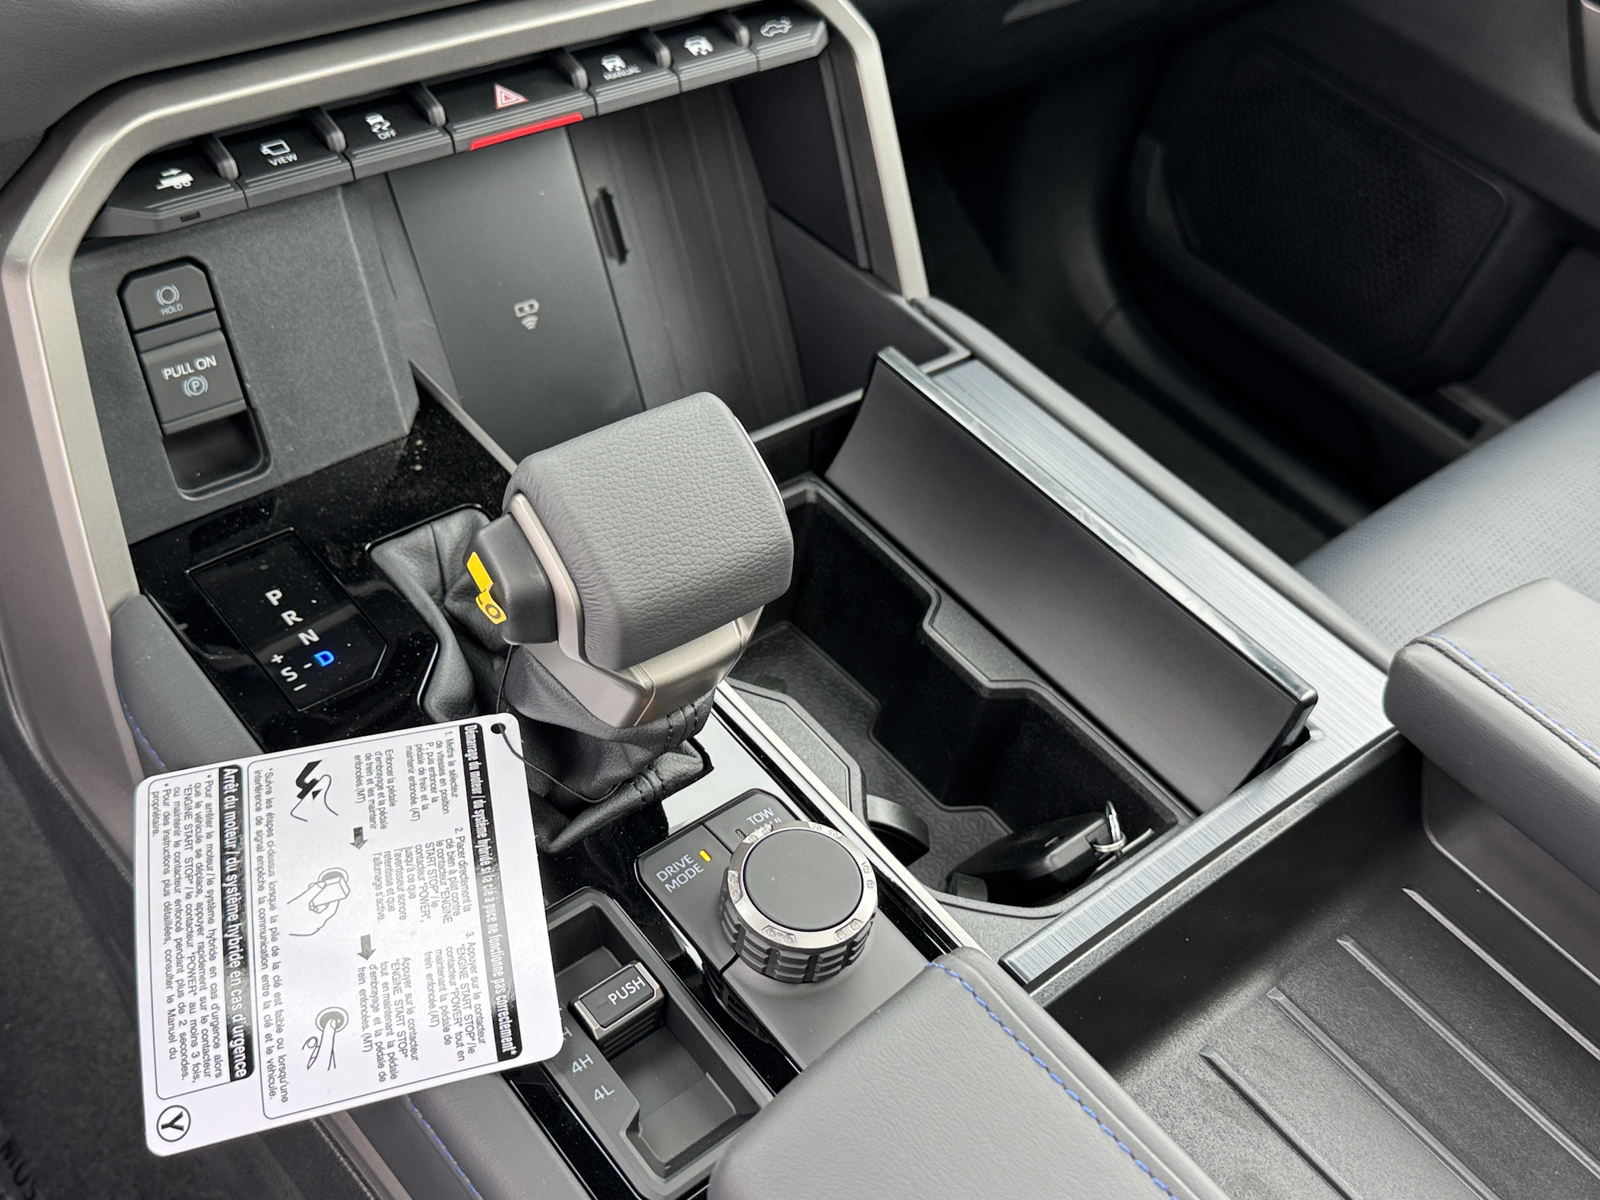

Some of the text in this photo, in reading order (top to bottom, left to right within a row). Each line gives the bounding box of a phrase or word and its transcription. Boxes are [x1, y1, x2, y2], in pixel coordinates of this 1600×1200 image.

[377, 127, 397, 140] OFF
[268, 152, 298, 166] VIEW
[161, 303, 183, 316] HOLD
[162, 355, 217, 380] PULL ON
[265, 589, 283, 606] P
[281, 610, 304, 626] R
[298, 628, 320, 646] N
[313, 650, 335, 668] D
[461, 724, 480, 761] Démarrage
[384, 749, 394, 776] Enfoncer
[468, 760, 481, 770] du
[173, 786, 179, 797] ou
[192, 782, 201, 797] que
[204, 780, 213, 798] Pour
[223, 767, 236, 793] Arrêt
[469, 770, 484, 795] moteur
[195, 800, 203, 808] le
[224, 794, 237, 809] du
[265, 797, 273, 809] les
[385, 784, 397, 807] pédale
[473, 798, 486, 808] du
[149, 791, 160, 836] propriétaire.
[173, 800, 182, 836] maintenir
[205, 802, 213, 828] arrêter
[263, 811, 275, 837] étapes
[471, 808, 490, 839] système
[746, 807, 774, 825] TOW
[184, 823, 193, 851] START
[195, 811, 204, 843] véhicule
[206, 831, 214, 839] le
[224, 810, 238, 849] moteur
[174, 839, 182, 847] le
[196, 848, 202, 858] se
[455, 836, 465, 859] Placer
[474, 838, 493, 866] hybride
[226, 856, 239, 872] du
[267, 839, 276, 877] ci-dessus
[481, 865, 494, 874] si
[656, 853, 695, 883] DRIVE
[174, 850, 183, 894] contacteur
[194, 861, 205, 899] déplace,
[207, 877, 215, 885] le
[402, 846, 415, 899] jusqu'à ce que
[458, 860, 470, 903] directement
[482, 874, 495, 883] la
[664, 862, 704, 893] MODE
[186, 890, 194, 899] le
[222, 873, 241, 922] système
[266, 880, 278, 911] lorsque
[483, 883, 496, 895] clé
[175, 898, 183, 932] enfoncé
[204, 888, 216, 924] système
[463, 904, 471, 912] la
[481, 903, 497, 923] puce
[161, 788, 177, 1059] Pour des instructions plus détaillées, consulter le Manuel du
[186, 902, 195, 948] contacteur
[194, 901, 204, 937] appuyer
[270, 914, 278, 923] la
[487, 923, 498, 934] ne
[205, 928, 218, 961] hybride
[254, 769, 277, 1099] interférence de signal empêche la communication entre la clé et le véhicule.
[268, 926, 279, 942] pile
[173, 936, 185, 974] pendant
[224, 923, 243, 969] hybride
[272, 945, 280, 956] de
[488, 934, 506, 977] fonctionne
[195, 940, 208, 991] rapidement
[272, 961, 281, 970] la
[464, 941, 478, 975] Appuyer
[210, 965, 216, 978] en
[230, 970, 242, 986] en
[273, 974, 282, 988] clé
[174, 978, 186, 998] plus
[473, 991, 481, 1000] le
[490, 978, 505, 994] pas
[607, 976, 646, 1005] PUSH
[178, 1001, 187, 1014] de
[189, 1001, 196, 1014] au
[231, 988, 243, 1010] cas
[274, 991, 283, 1006] est
[201, 1014, 210, 1024] le
[209, 1002, 222, 1049] d'urgence
[275, 1008, 285, 1033] faible
[366, 963, 387, 1082] d'embrayage et la pédale de
[379, 961, 398, 1080] tout en maintenant la pédale
[474, 1003, 487, 1044] contacteur
[190, 1018, 200, 1047] moins
[277, 1037, 284, 1049] ou
[179, 1031, 190, 1080] secondes.
[202, 1027, 212, 1078] contacteur
[228, 1012, 249, 1078] d'urgence
[190, 1062, 201, 1083] fois,
[214, 1053, 223, 1078] alors
[571, 1053, 594, 1074] 4H
[276, 1054, 290, 1103] lorsqu'une
[593, 1084, 615, 1102] 4L
[160, 1111, 183, 1136] Y
